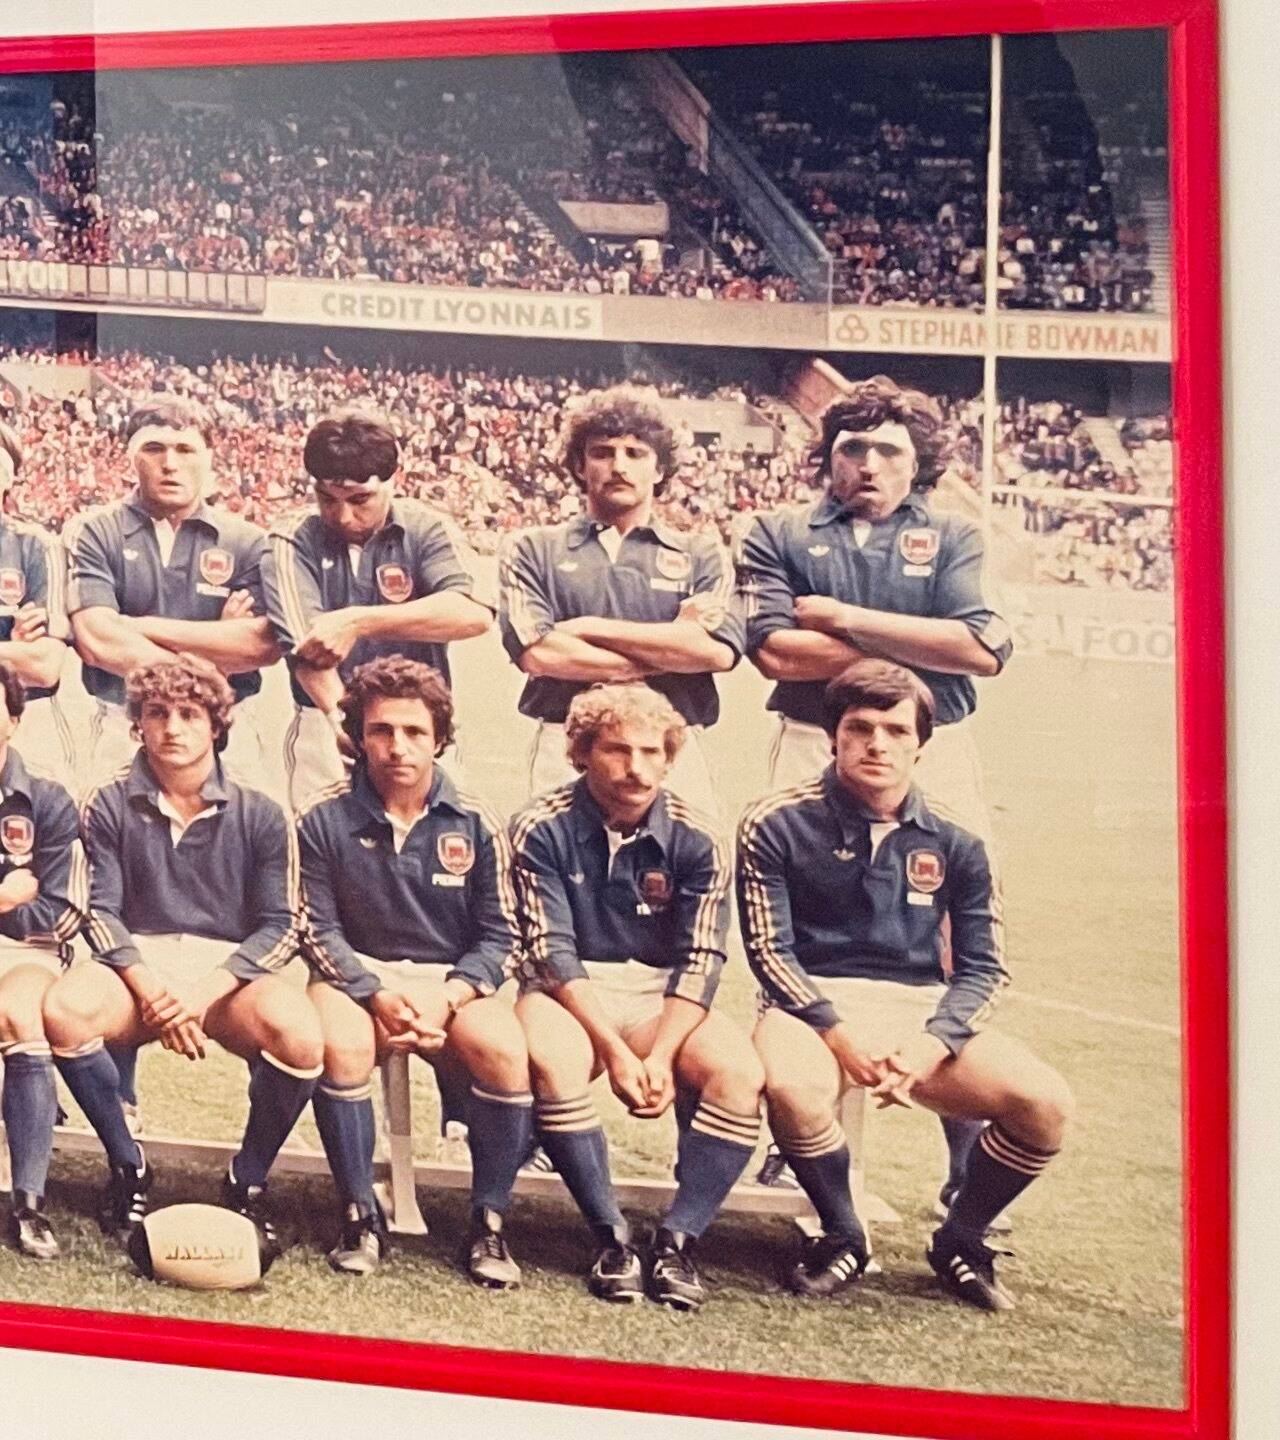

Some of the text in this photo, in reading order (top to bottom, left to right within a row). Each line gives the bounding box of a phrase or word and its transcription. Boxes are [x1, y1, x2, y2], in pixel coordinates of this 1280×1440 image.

[320, 292, 592, 330] CREDIT LYONNAIS
[1027, 324, 1159, 353] BOWMAN
